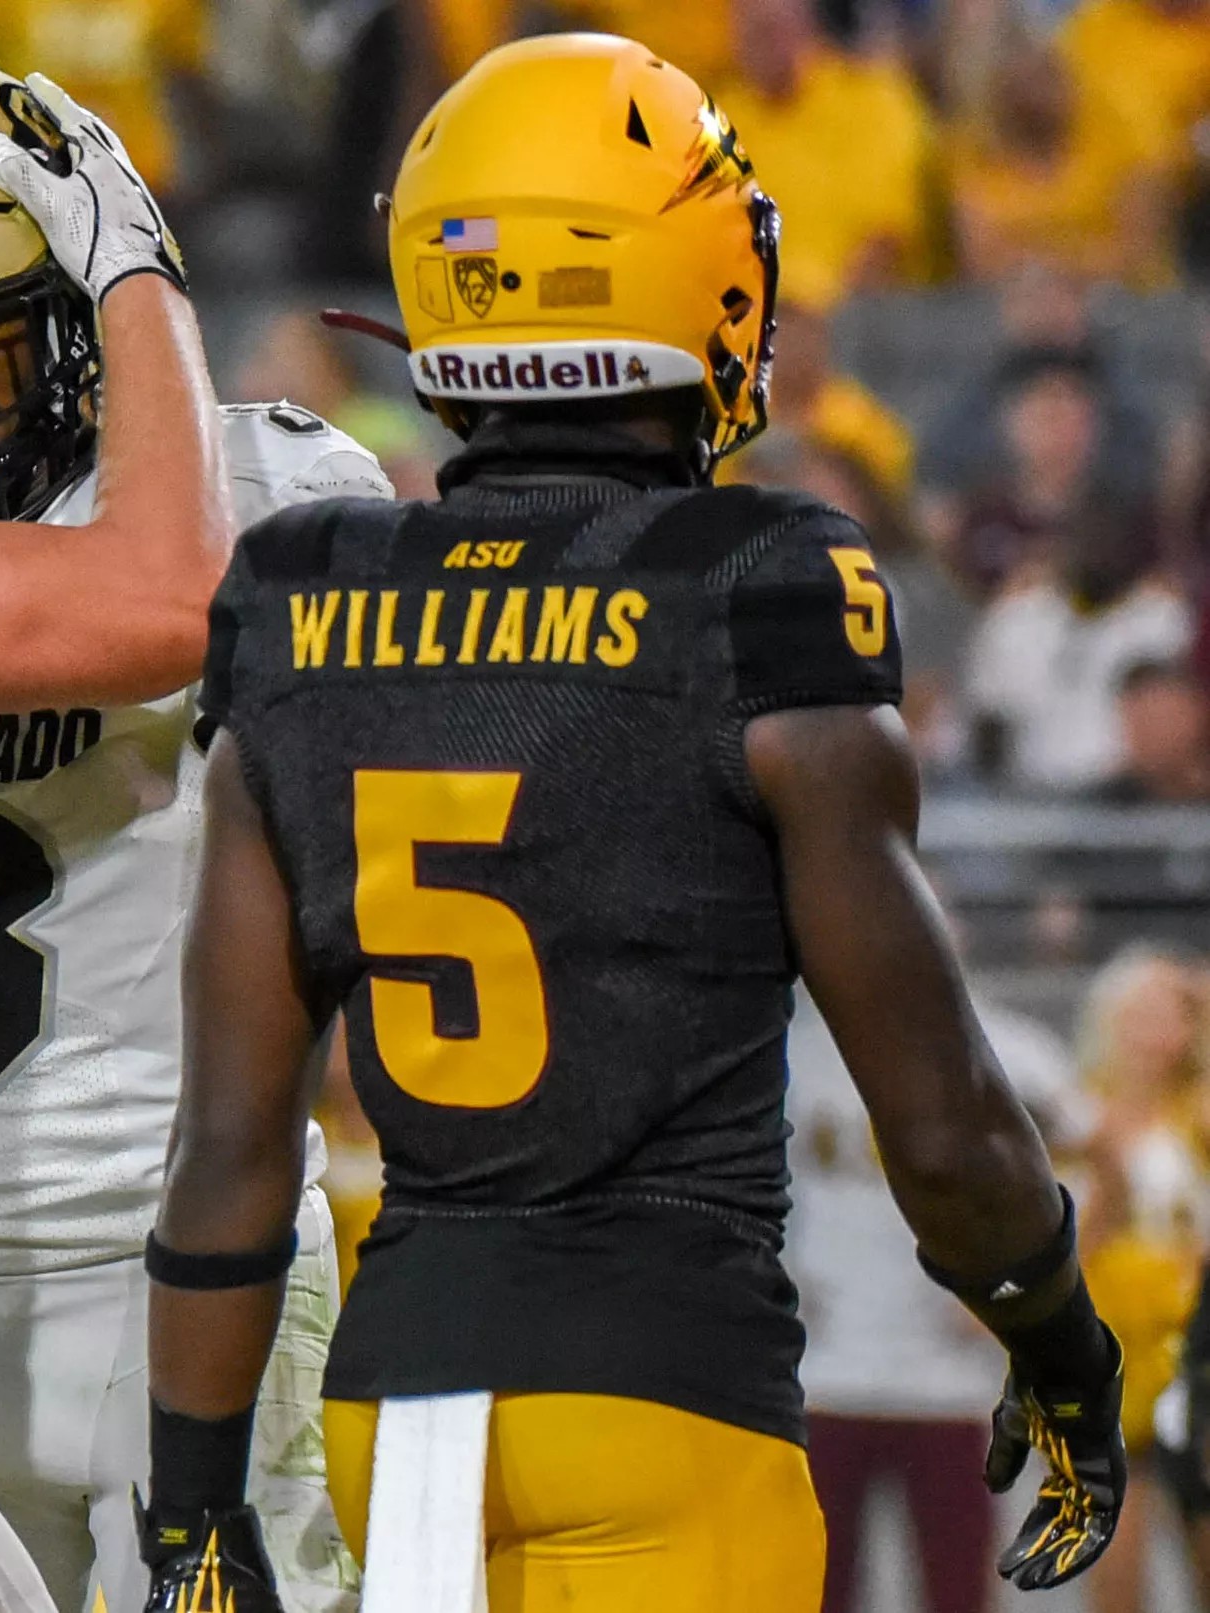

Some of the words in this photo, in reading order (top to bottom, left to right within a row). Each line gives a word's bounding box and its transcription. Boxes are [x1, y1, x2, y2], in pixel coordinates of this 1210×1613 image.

[436, 351, 620, 391] Riddell
[443, 540, 528, 569] ASU
[289, 585, 649, 670] WILLIAMS
[828, 547, 887, 658] 5
[352, 768, 550, 1110] 5
